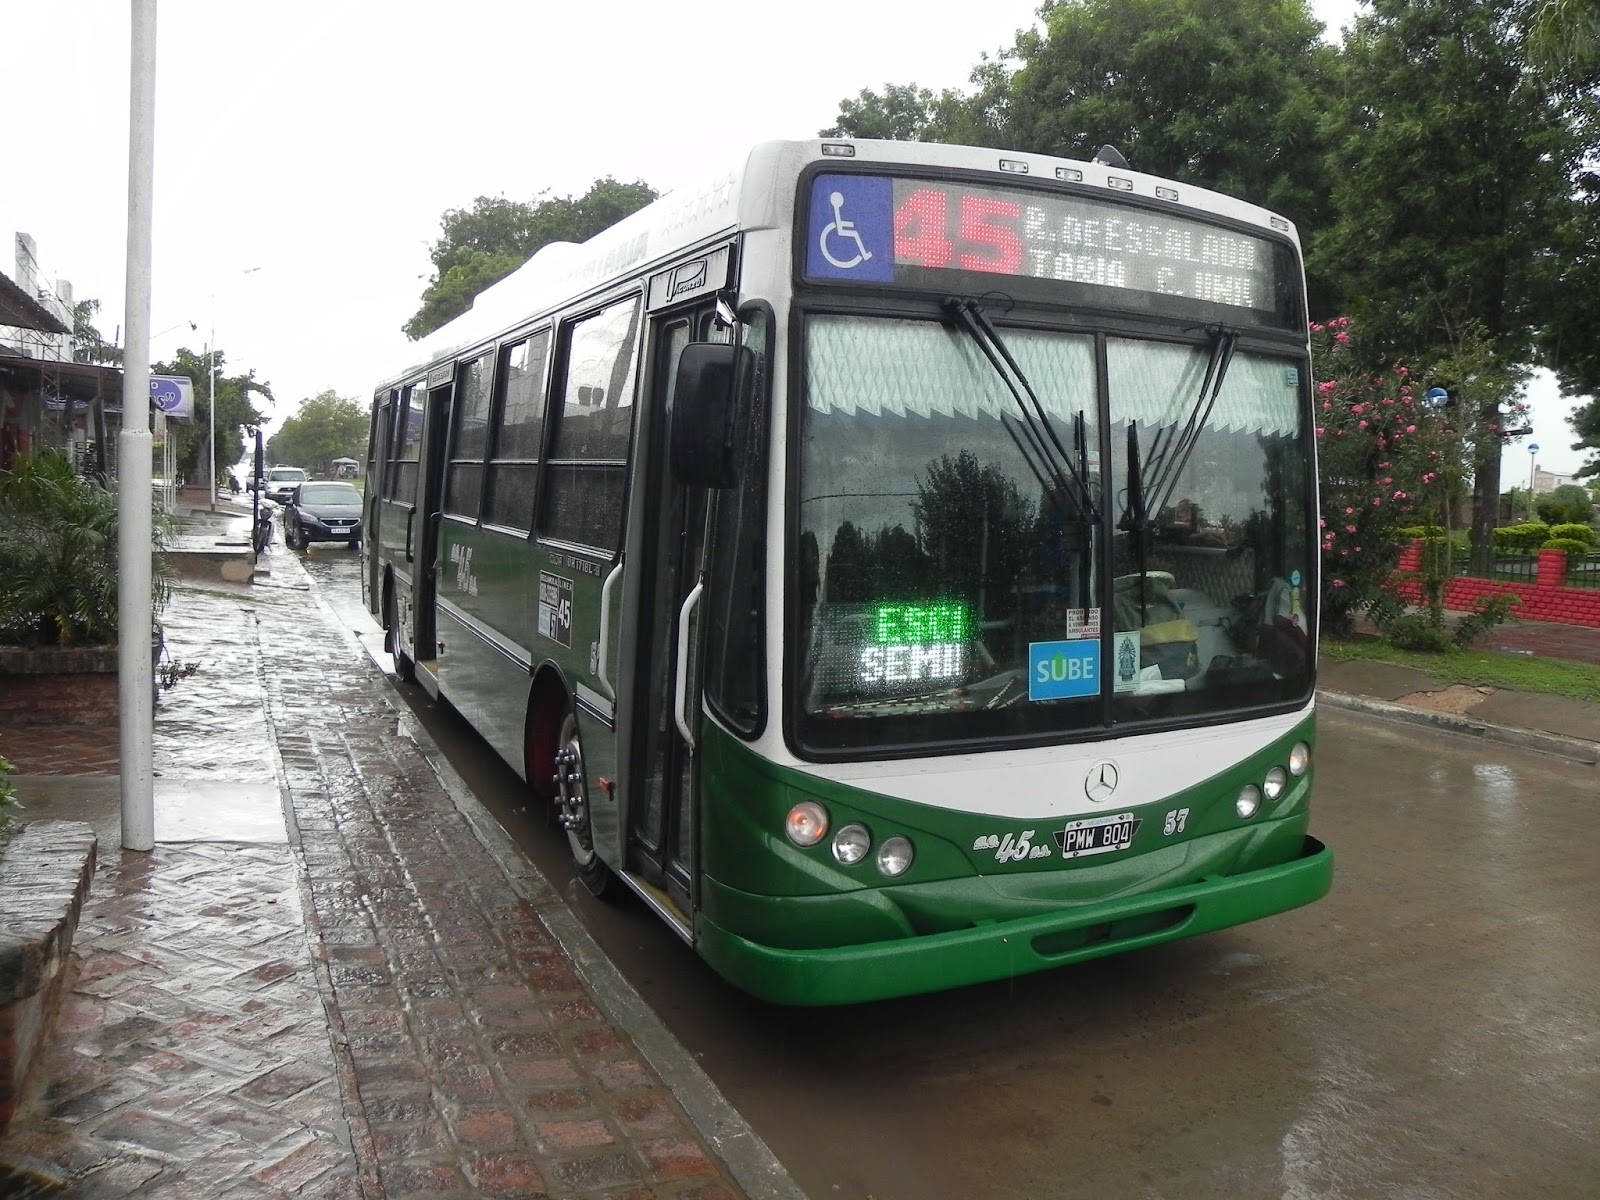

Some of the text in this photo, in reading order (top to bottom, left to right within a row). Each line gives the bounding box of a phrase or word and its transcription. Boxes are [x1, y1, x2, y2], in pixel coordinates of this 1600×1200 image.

[895, 189, 1024, 274] 45
[558, 598, 571, 629] 45
[1037, 654, 1094, 684] SUBE
[1066, 822, 1130, 851] PMW 804
[1163, 808, 1190, 836] 57
[995, 829, 1036, 864] 45
